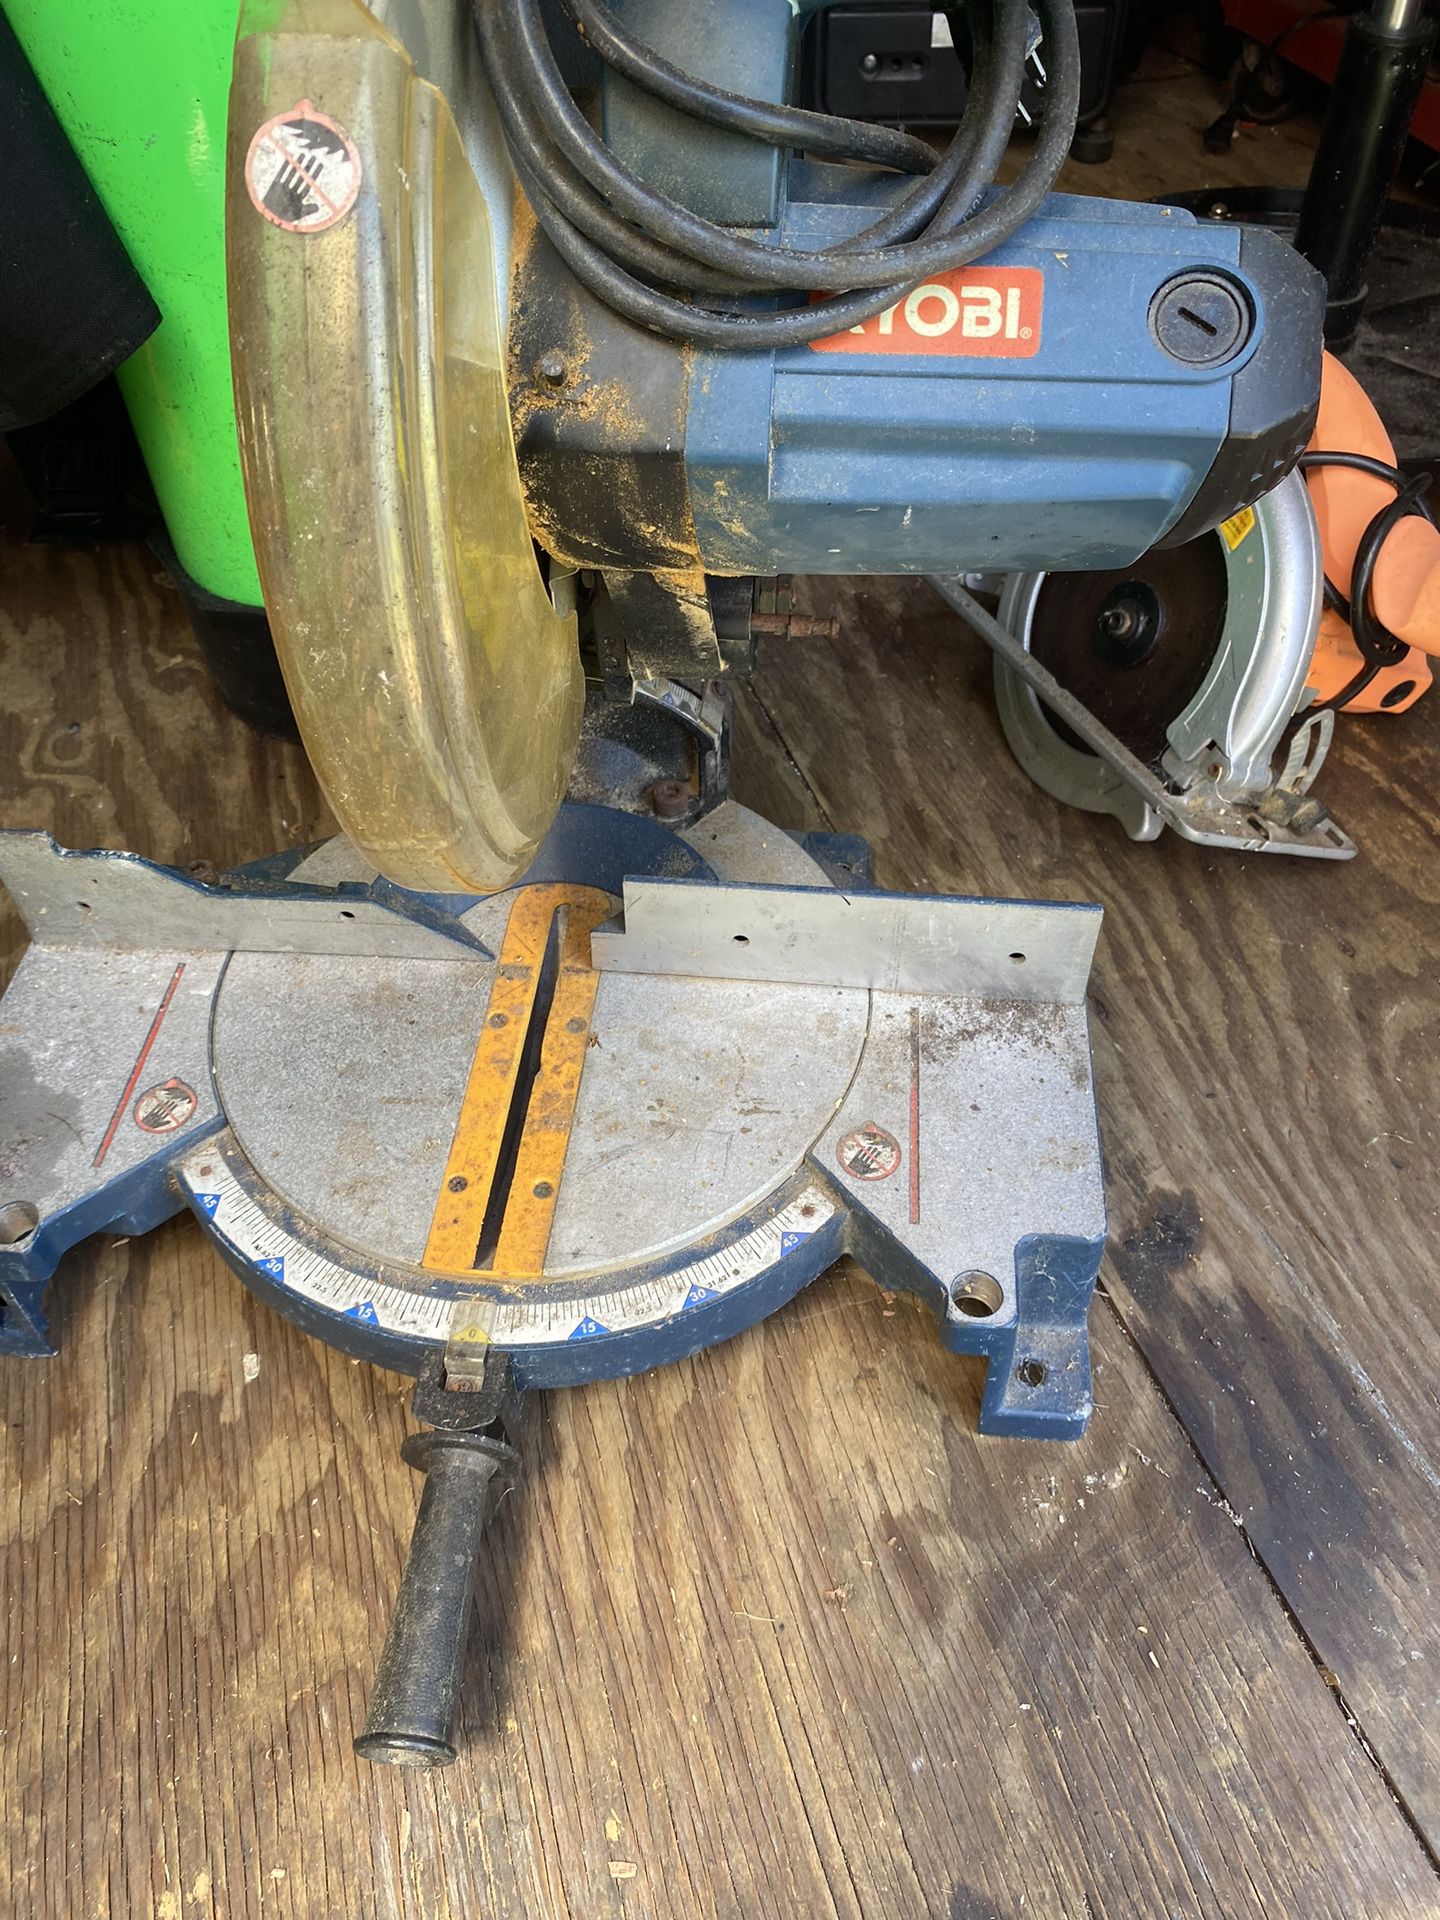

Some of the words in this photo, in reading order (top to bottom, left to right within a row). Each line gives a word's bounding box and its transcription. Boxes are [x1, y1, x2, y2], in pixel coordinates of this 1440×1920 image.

[849, 284, 1021, 339] YOBI
[203, 1195, 218, 1208] 45
[783, 1234, 799, 1248] 45
[266, 1259, 282, 1273] 30
[312, 1282, 328, 1293] 22.5
[690, 1288, 706, 1302] 30
[358, 1305, 373, 1318] 15
[581, 1321, 597, 1334] 15
